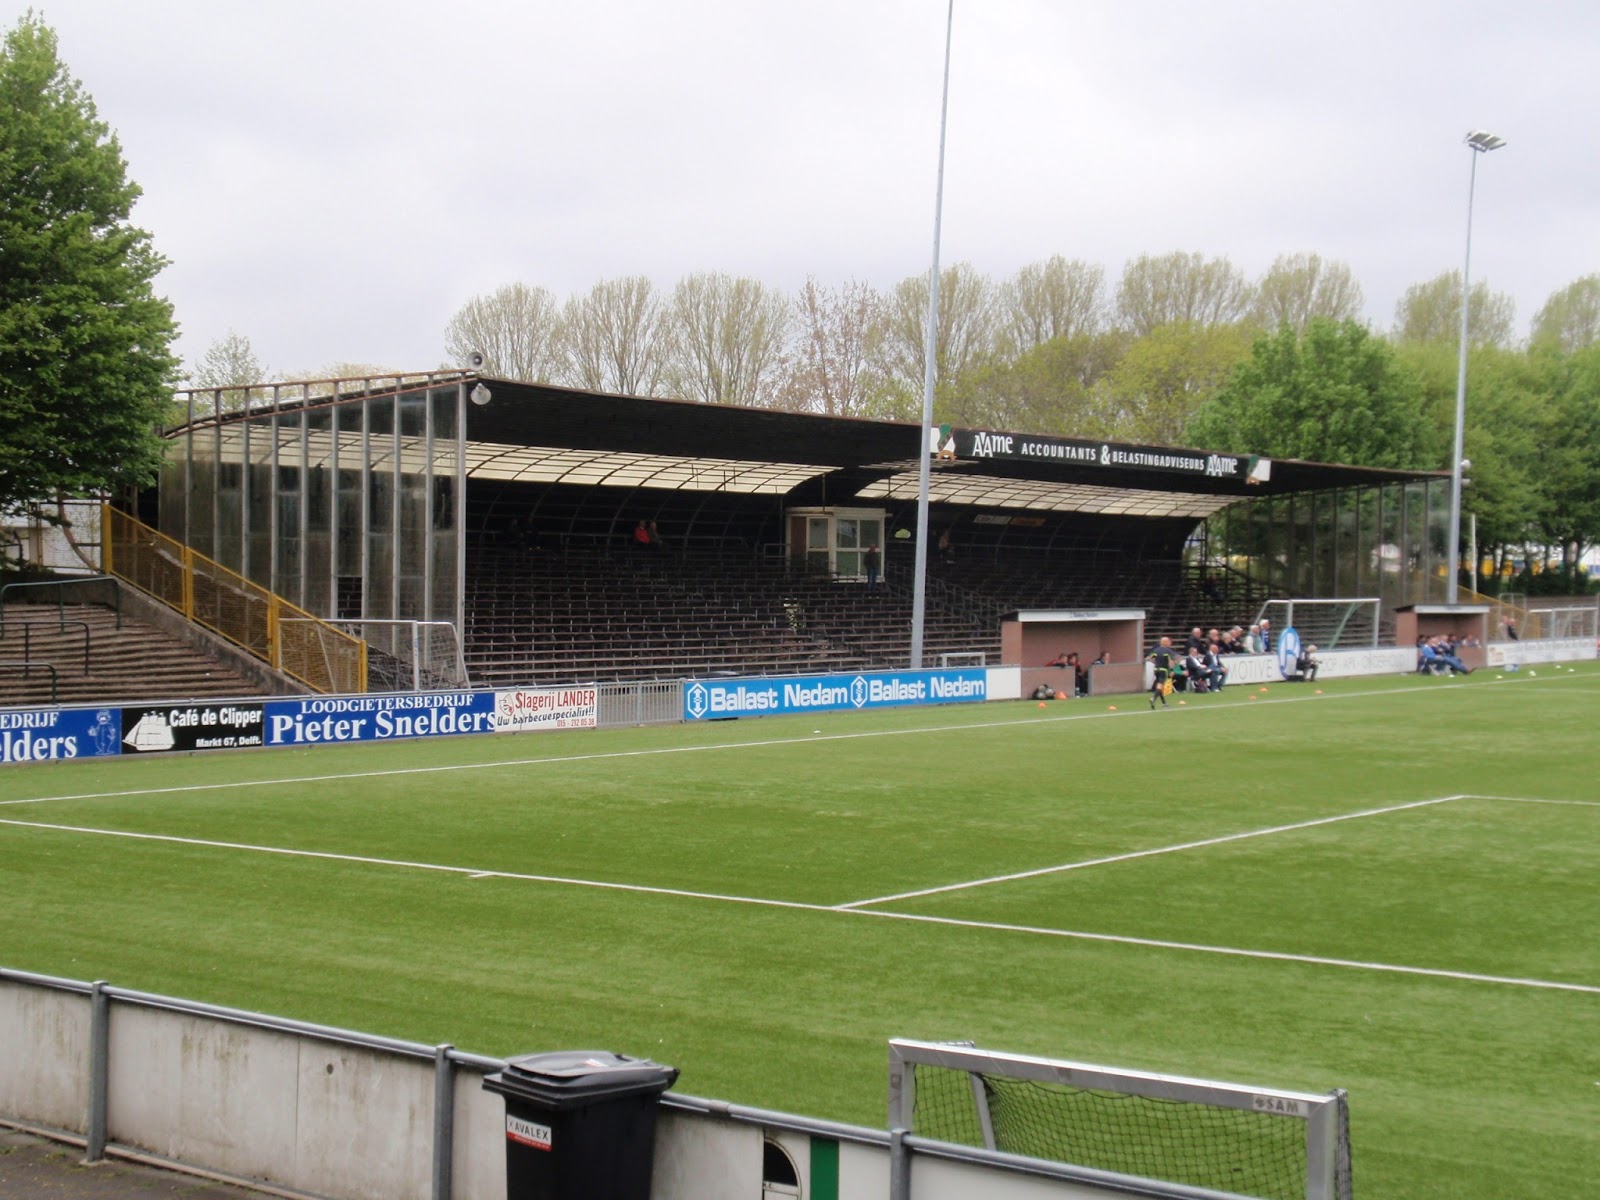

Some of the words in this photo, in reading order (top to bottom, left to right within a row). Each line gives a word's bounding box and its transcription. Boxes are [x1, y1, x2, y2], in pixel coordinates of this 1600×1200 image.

[1021, 442, 1097, 460] ACCOUNTANTS
[1100, 445, 1111, 465] &
[1112, 451, 1205, 471] BELASTINGADVISEURS
[710, 686, 778, 712] Ballast
[784, 682, 848, 707] Nedam
[869, 679, 926, 702] Ballast
[930, 676, 985, 698] Nedam
[301, 694, 475, 714] LOODGIETERSBEDRIJF
[515, 691, 555, 711] Slagerij
[557, 690, 595, 707] LANDER
[169, 708, 199, 728] Café
[201, 708, 218, 726] de
[219, 707, 262, 728] Clipper
[269, 714, 367, 744] Pieter
[375, 707, 495, 739] Snelders
[497, 716, 510, 726] Uw
[513, 706, 595, 725] barbecuespecialist!!
[0, 730, 77, 762] lders
[195, 737, 222, 747] Markt
[223, 737, 238, 747] 67,
[239, 735, 262, 745] Delft.
[1266, 1097, 1298, 1114] SAM
[515, 1121, 548, 1141] AVALEX
